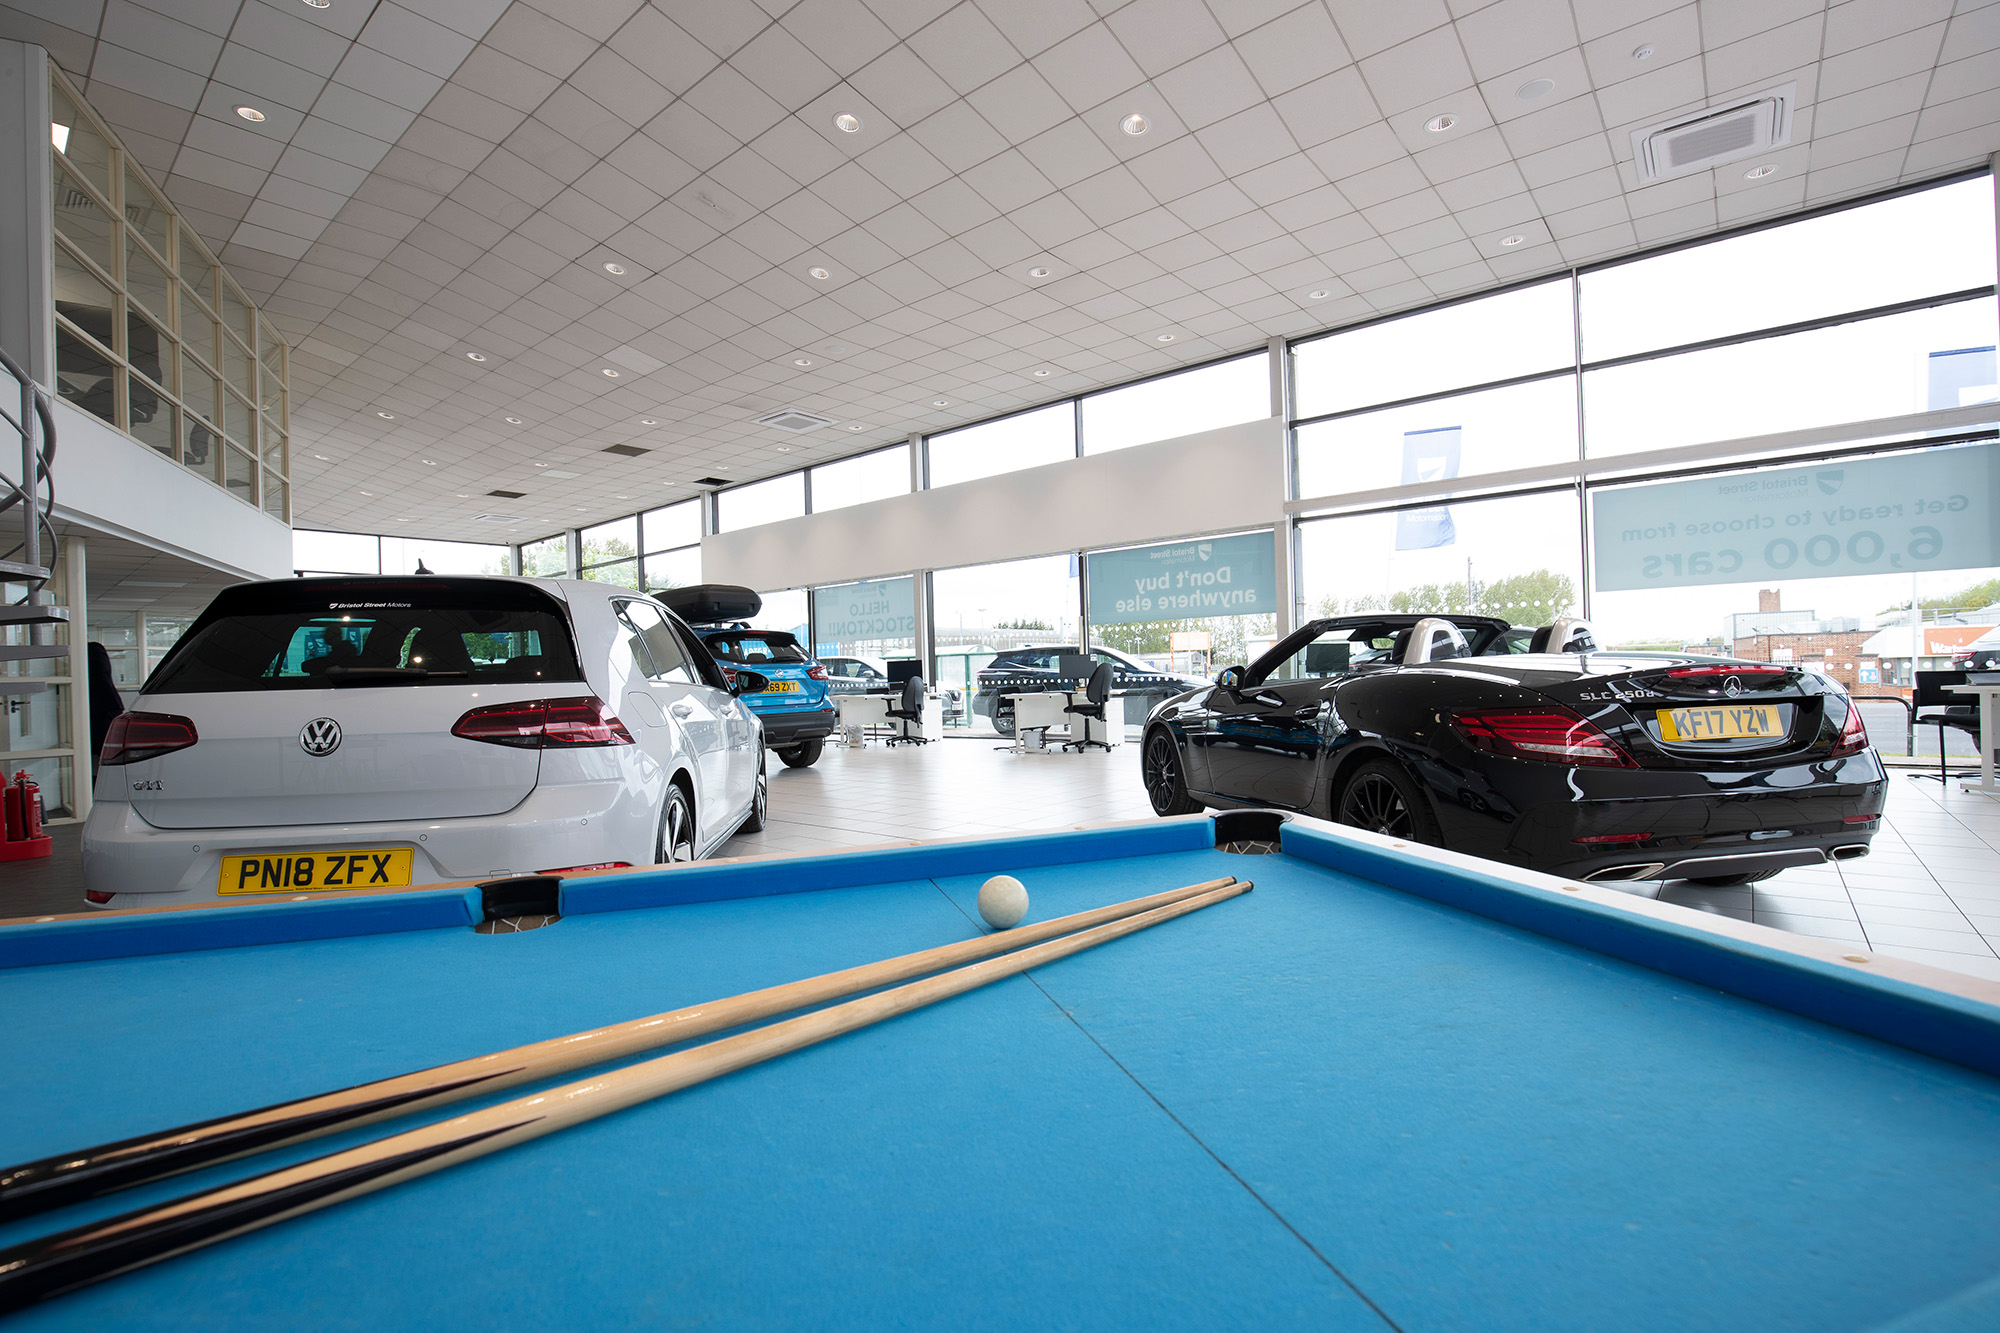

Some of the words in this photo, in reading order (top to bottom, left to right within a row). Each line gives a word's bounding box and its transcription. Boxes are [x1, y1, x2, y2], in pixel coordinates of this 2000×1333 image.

[781, 682, 796, 692] ZXT
[1579, 691, 1612, 700] SLC
[1613, 690, 1655, 700] 250d
[1672, 711, 1724, 737] KF17
[1729, 709, 1770, 734] YZW
[238, 857, 315, 889] PN18
[323, 854, 392, 885] ZFX
